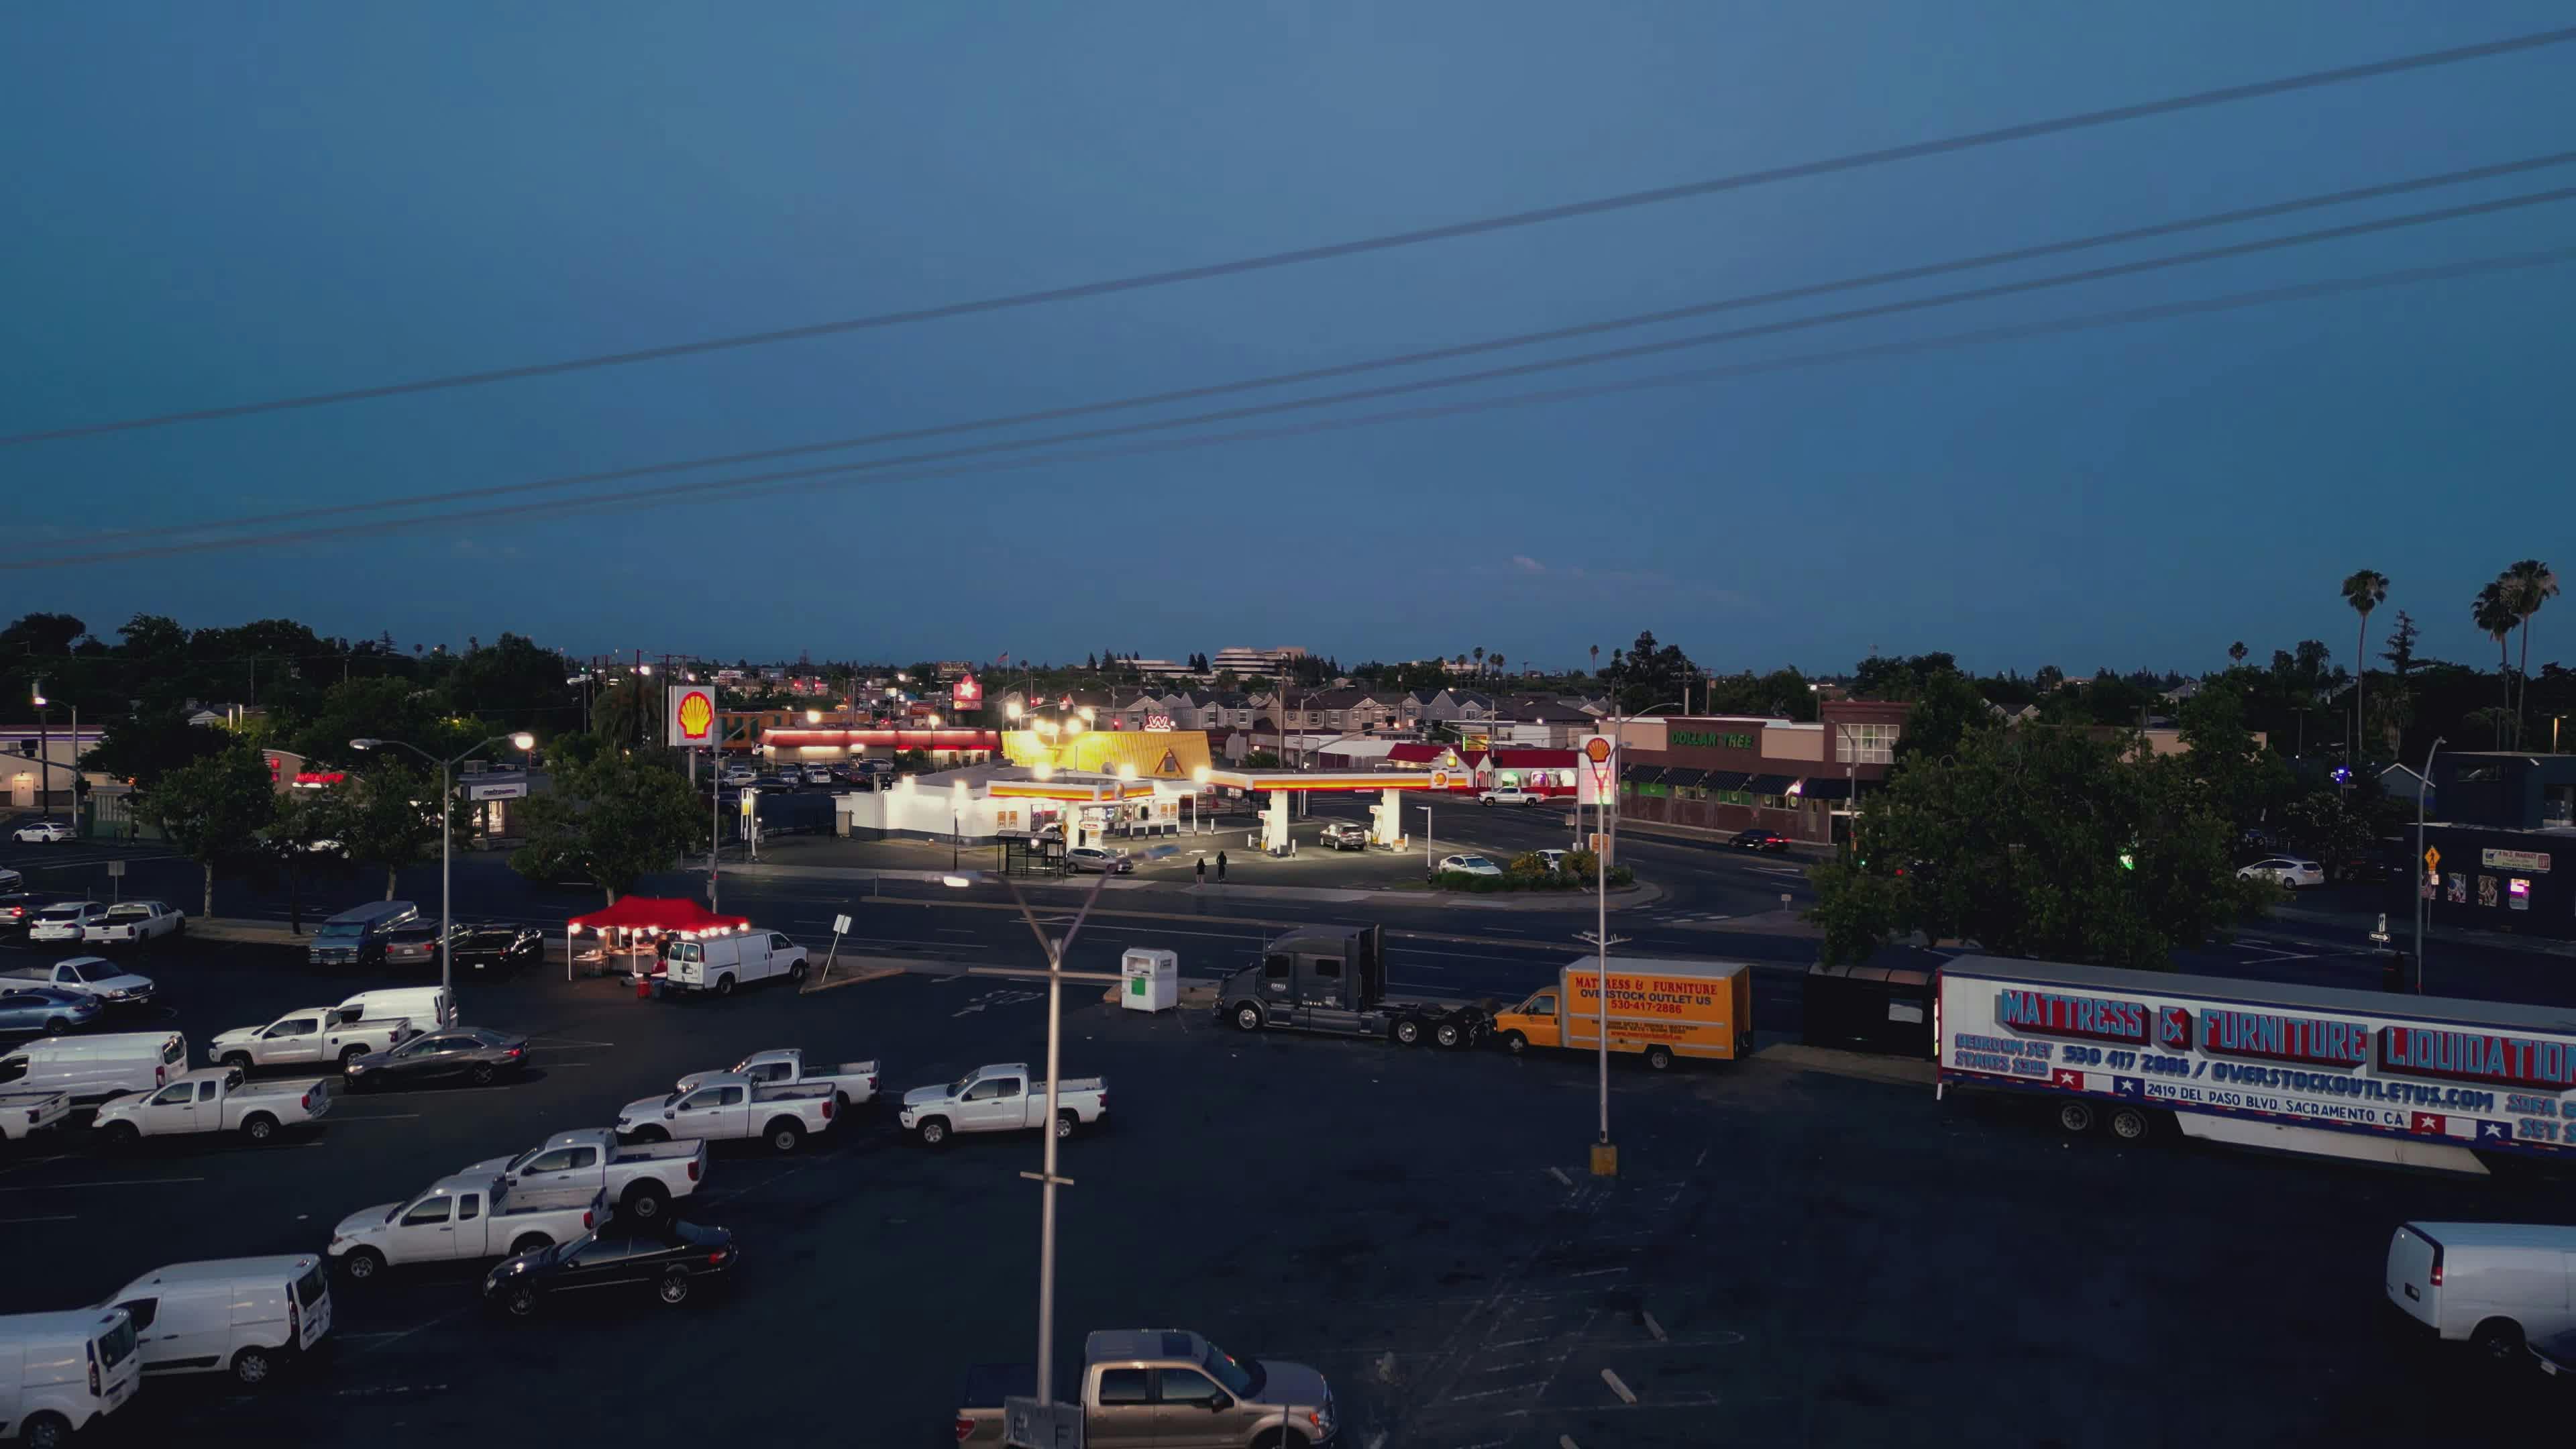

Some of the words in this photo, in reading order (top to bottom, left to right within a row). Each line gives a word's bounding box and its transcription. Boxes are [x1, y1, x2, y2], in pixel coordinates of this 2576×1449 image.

[1671, 730, 1717, 746] DOLLAR
[1723, 734, 1753, 749] TREE
[1576, 977, 1630, 989] MATRESS
[1635, 979, 1643, 990] &
[1653, 981, 1717, 996] FURNITURE
[1611, 1000, 1682, 1014] 530-417-2886
[1649, 993, 1693, 1004] OUTLET
[1696, 996, 1711, 1006] US
[2001, 989, 2142, 1037] MATTRESS
[2160, 1007, 2184, 1042] &
[2201, 1008, 2367, 1061] FURNITURE
[1955, 1033, 2025, 1055] BEDROOM
[2026, 1040, 2053, 1058] SET
[1955, 1051, 2010, 1073] STARTS
[2062, 1045, 2101, 1065] 530
[2106, 1050, 2136, 1071] 417
[2211, 1062, 2493, 1111] OVERSTOCKOUTLETUS.COM
[2147, 1083, 2176, 1097] 2419
[2181, 1087, 2202, 1101] DEL
[2209, 1091, 2241, 1106] PASO
[2384, 1112, 2404, 1126] CA
[2506, 1094, 2557, 1116] SOFA
[2518, 1118, 2561, 1138] SET
